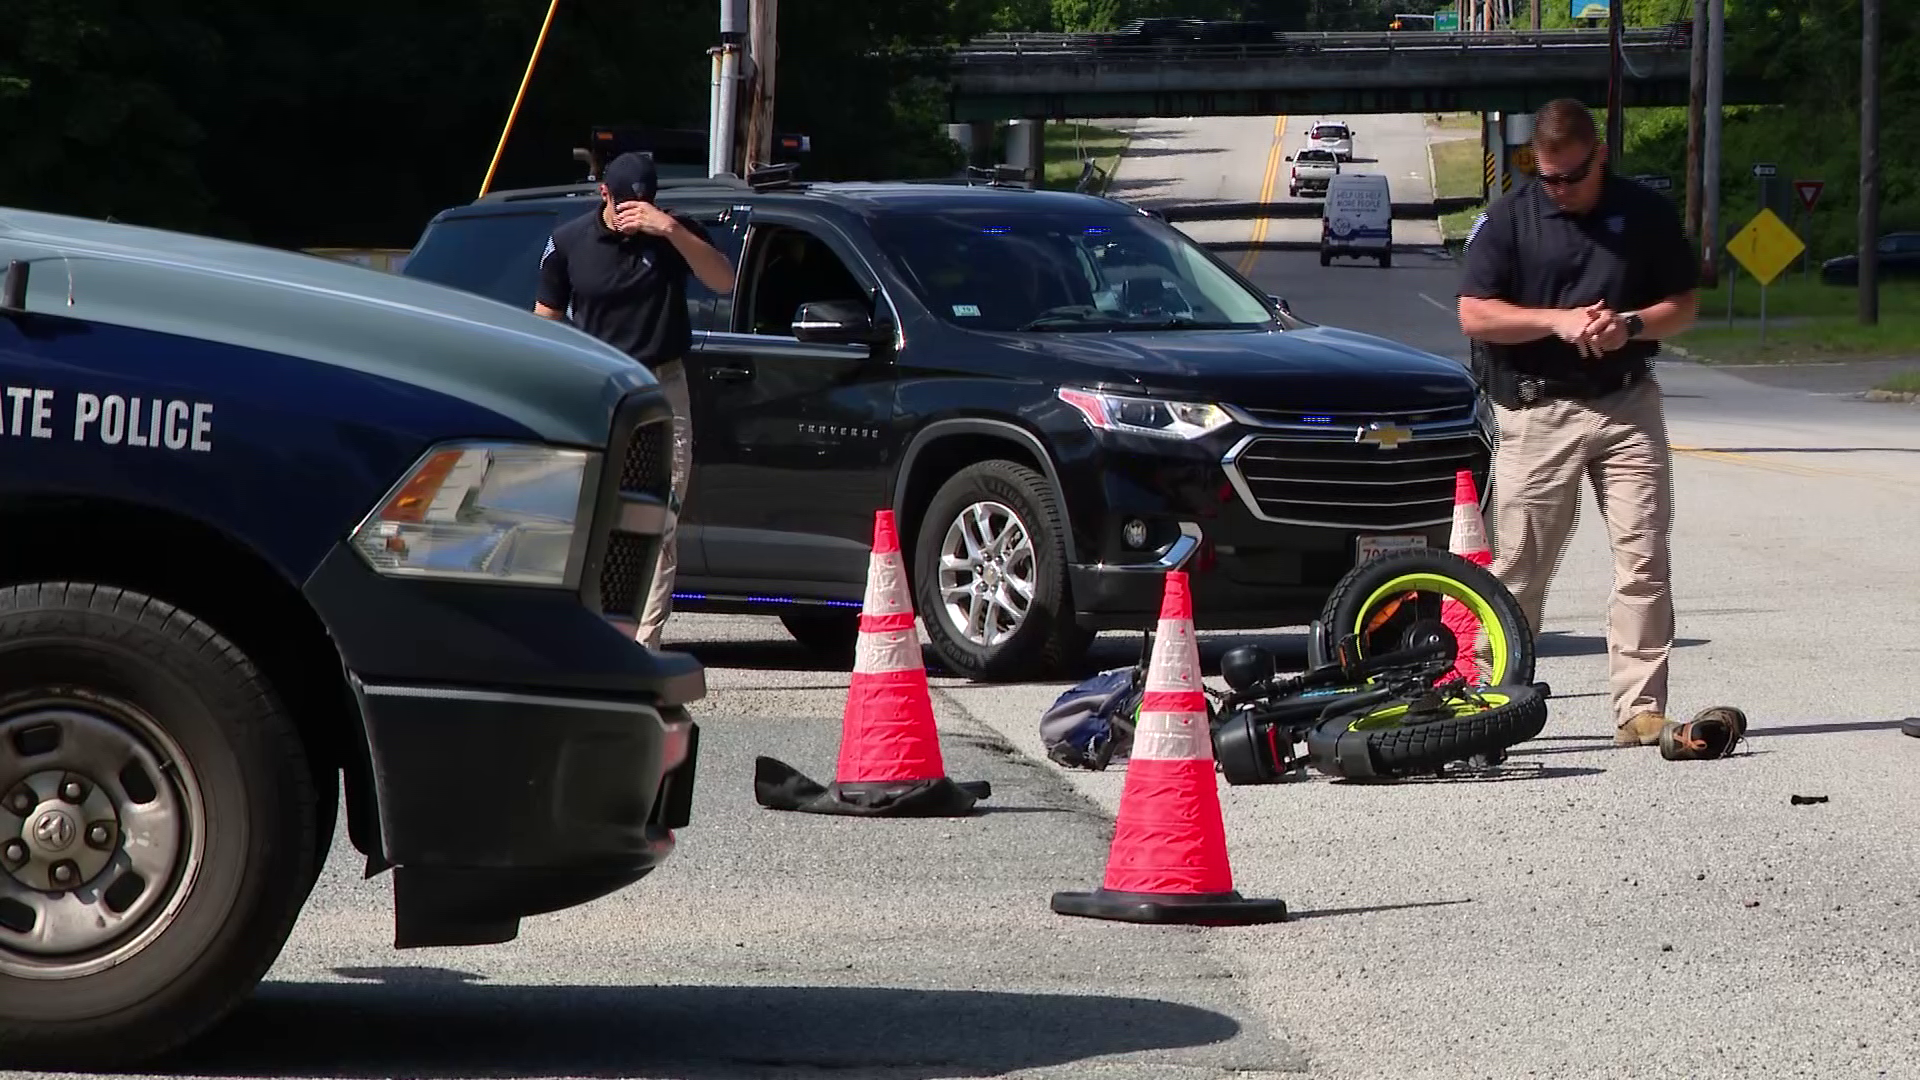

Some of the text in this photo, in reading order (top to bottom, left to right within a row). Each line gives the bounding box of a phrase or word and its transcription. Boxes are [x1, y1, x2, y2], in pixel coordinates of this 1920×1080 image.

[1337, 191, 1382, 199] HELP US HELP
[1337, 199, 1381, 208] MORE PEOPLE
[0, 386, 214, 452] TE POLICE
[798, 423, 879, 439] TRAVERSE
